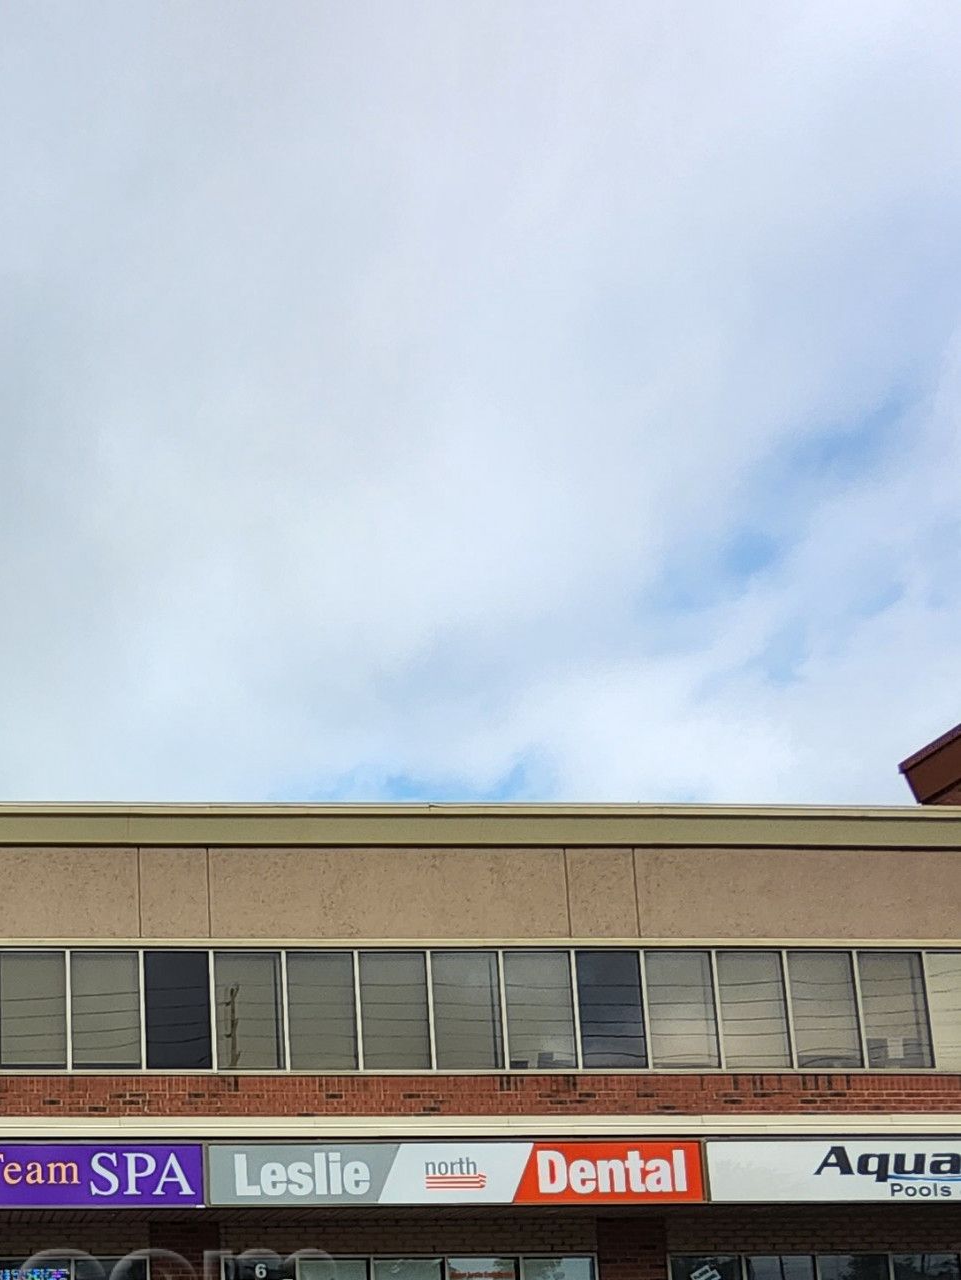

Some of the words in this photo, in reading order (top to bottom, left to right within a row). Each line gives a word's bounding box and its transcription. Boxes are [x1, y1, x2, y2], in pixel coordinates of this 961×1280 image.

[89, 1152, 196, 1196] SPA
[234, 1152, 371, 1196] Leslie
[425, 1157, 478, 1176] north
[537, 1149, 688, 1194] Dental
[813, 1146, 961, 1183] Aqua
[890, 1183, 952, 1197] Pools
[255, 1263, 267, 1279] 6
